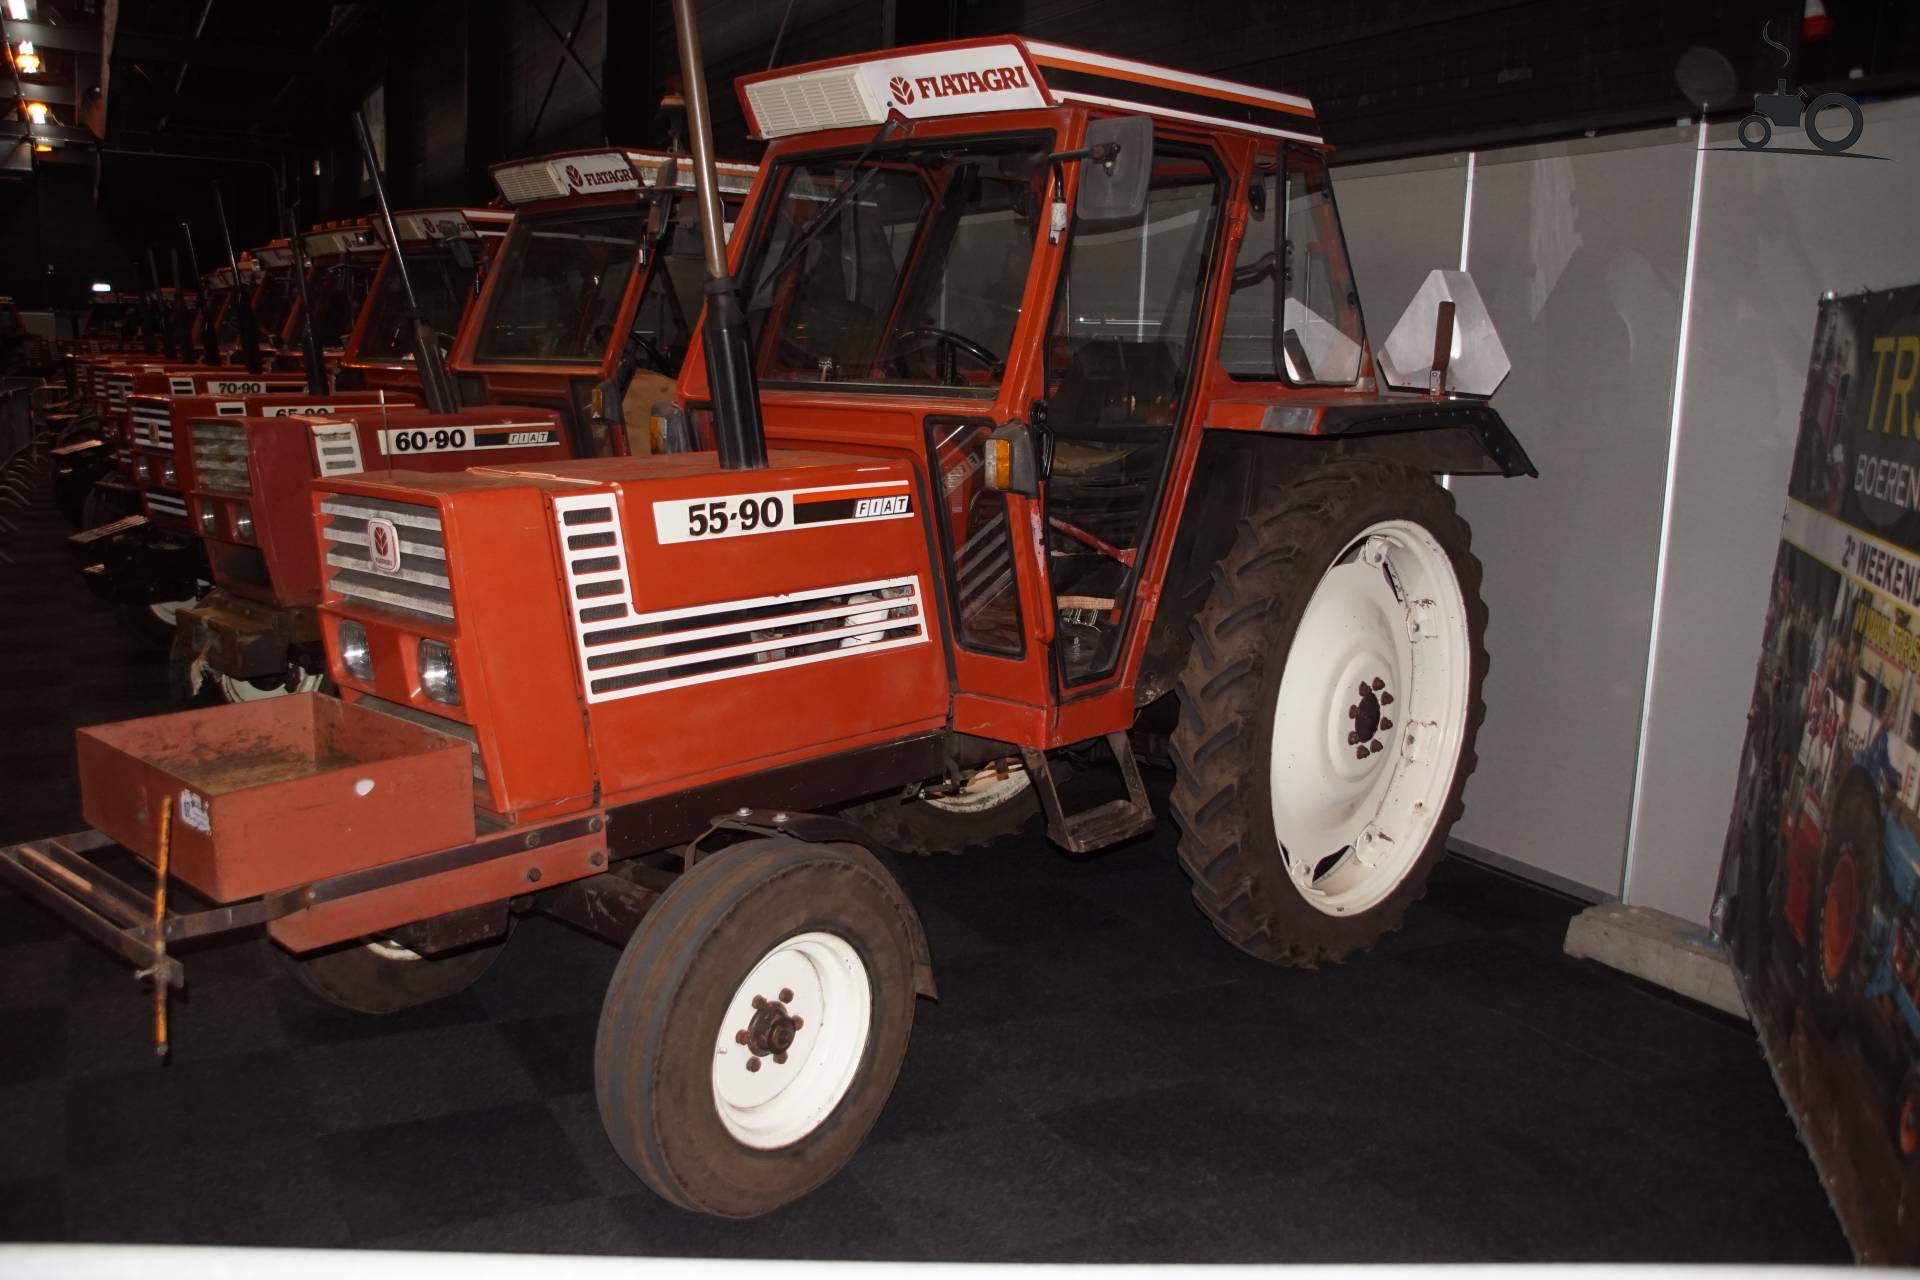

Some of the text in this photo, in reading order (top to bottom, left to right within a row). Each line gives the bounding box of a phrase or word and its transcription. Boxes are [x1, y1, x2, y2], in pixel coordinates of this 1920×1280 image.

[914, 66, 1030, 99] FIATAGRI
[508, 431, 549, 445] FIAT
[855, 495, 909, 518] FIAT
